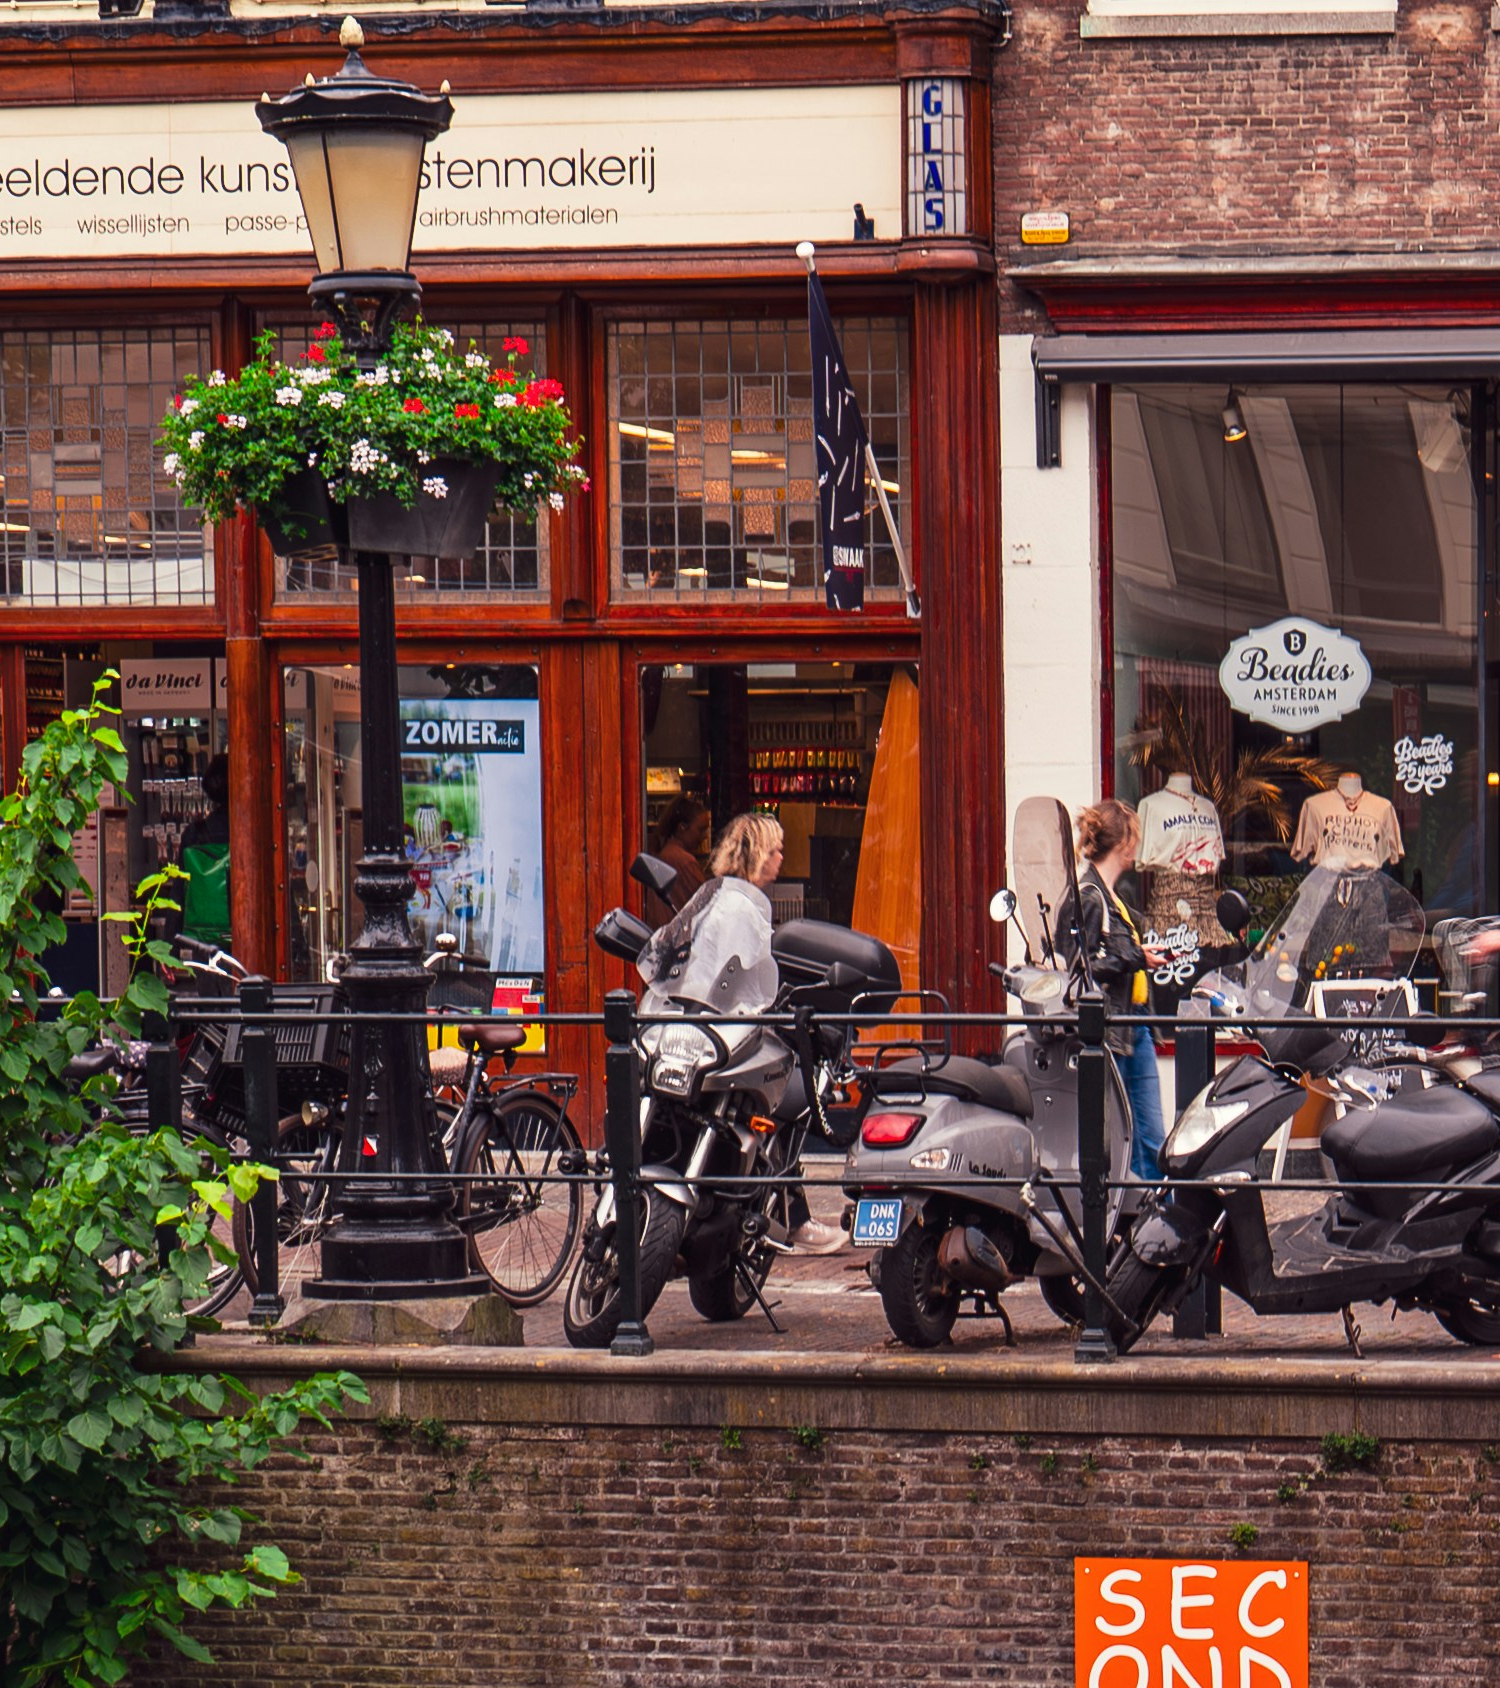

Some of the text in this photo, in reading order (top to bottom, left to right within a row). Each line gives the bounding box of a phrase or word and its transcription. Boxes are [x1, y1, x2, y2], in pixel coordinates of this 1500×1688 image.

[923, 85, 944, 230] GLAS
[199, 155, 299, 194] kuns
[77, 212, 189, 237] wissellijsten
[419, 204, 618, 229] airbrushmaterialen
[1237, 647, 1354, 685] Beadies
[1254, 687, 1337, 700] AMSTERDAM
[1271, 704, 1297, 716] SINCE
[405, 721, 498, 744] ZOMER
[1396, 761, 1417, 781] 25
[870, 1203, 895, 1219] DNK
[1095, 1565, 1286, 1640] SEC
